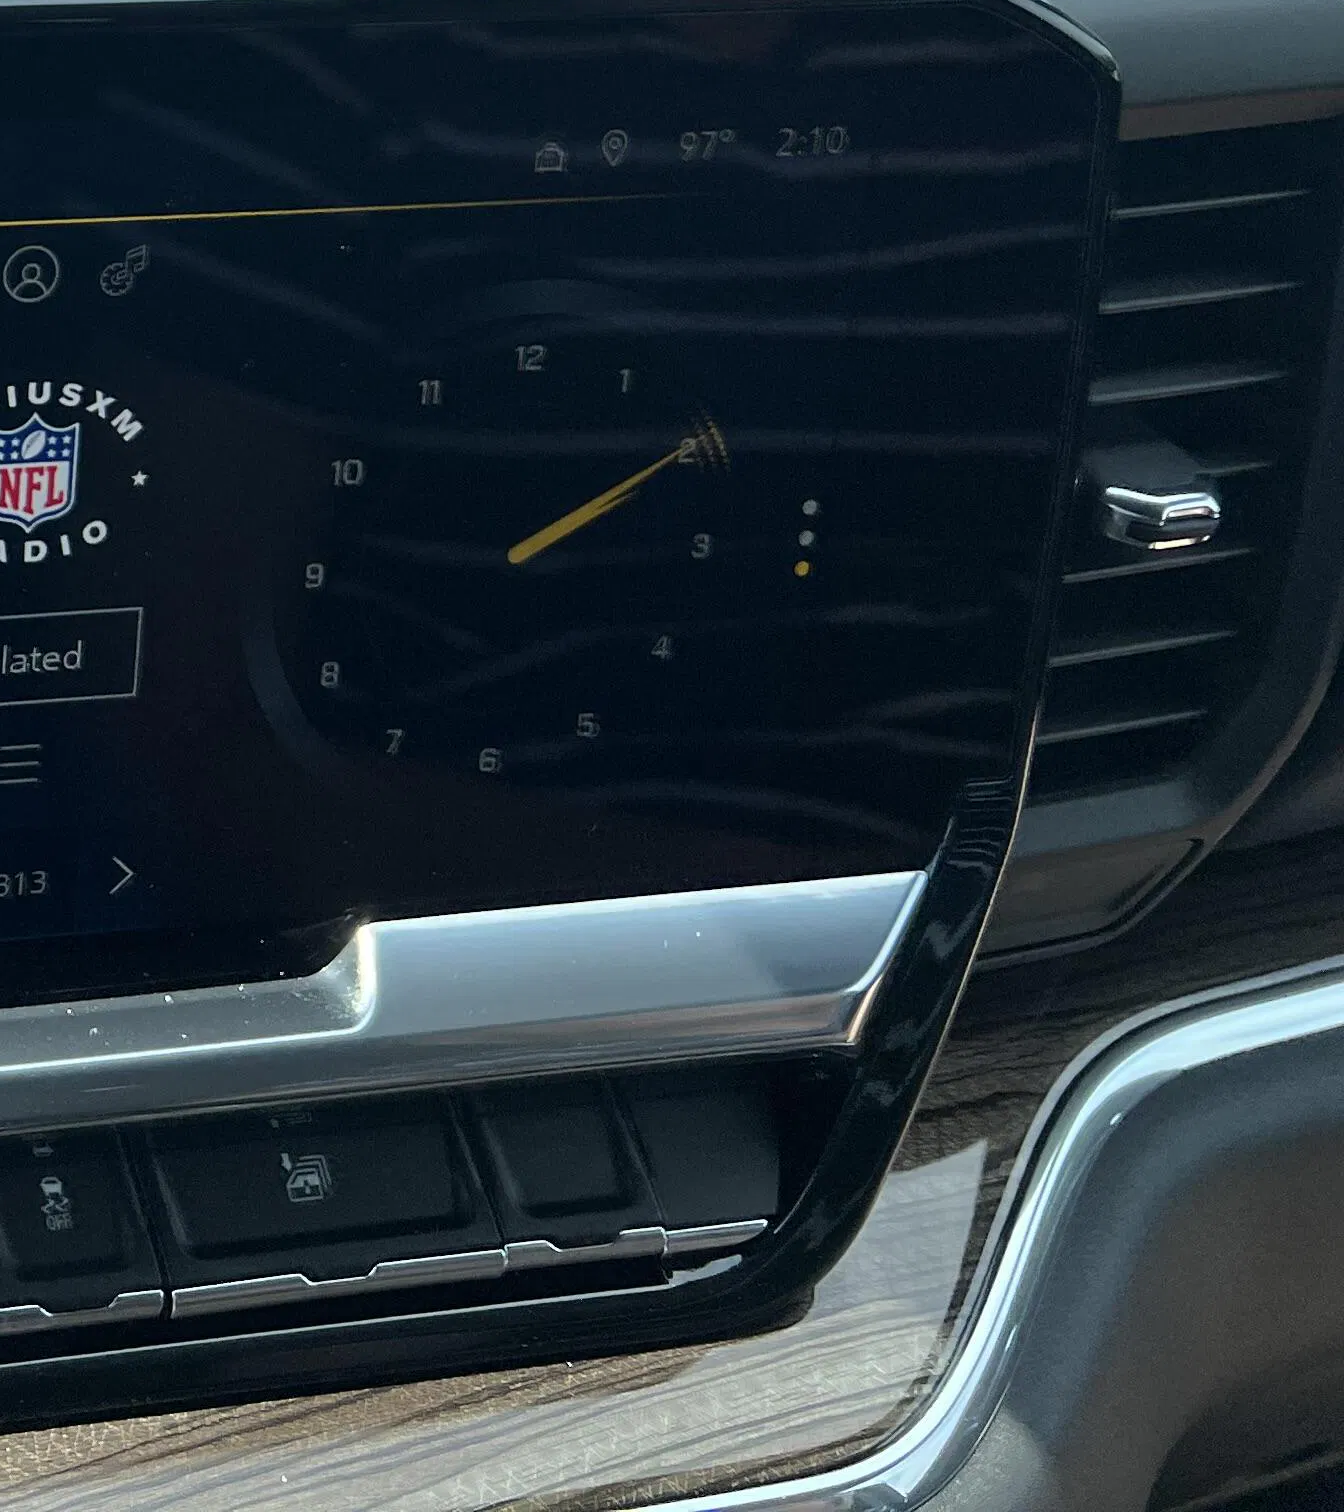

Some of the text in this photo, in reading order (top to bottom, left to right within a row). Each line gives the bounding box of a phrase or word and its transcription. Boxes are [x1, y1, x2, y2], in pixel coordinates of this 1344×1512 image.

[775, 126, 848, 157] 2:10
[515, 344, 547, 371] 12
[418, 379, 442, 405] 11
[619, 368, 631, 393] 1
[331, 458, 364, 486] 10
[691, 533, 711, 558] 3
[305, 563, 325, 589] 9
[650, 634, 672, 659] 4
[320, 661, 340, 688] 8
[576, 713, 599, 739] 5
[386, 729, 404, 754] 7
[478, 748, 502, 773] 6
